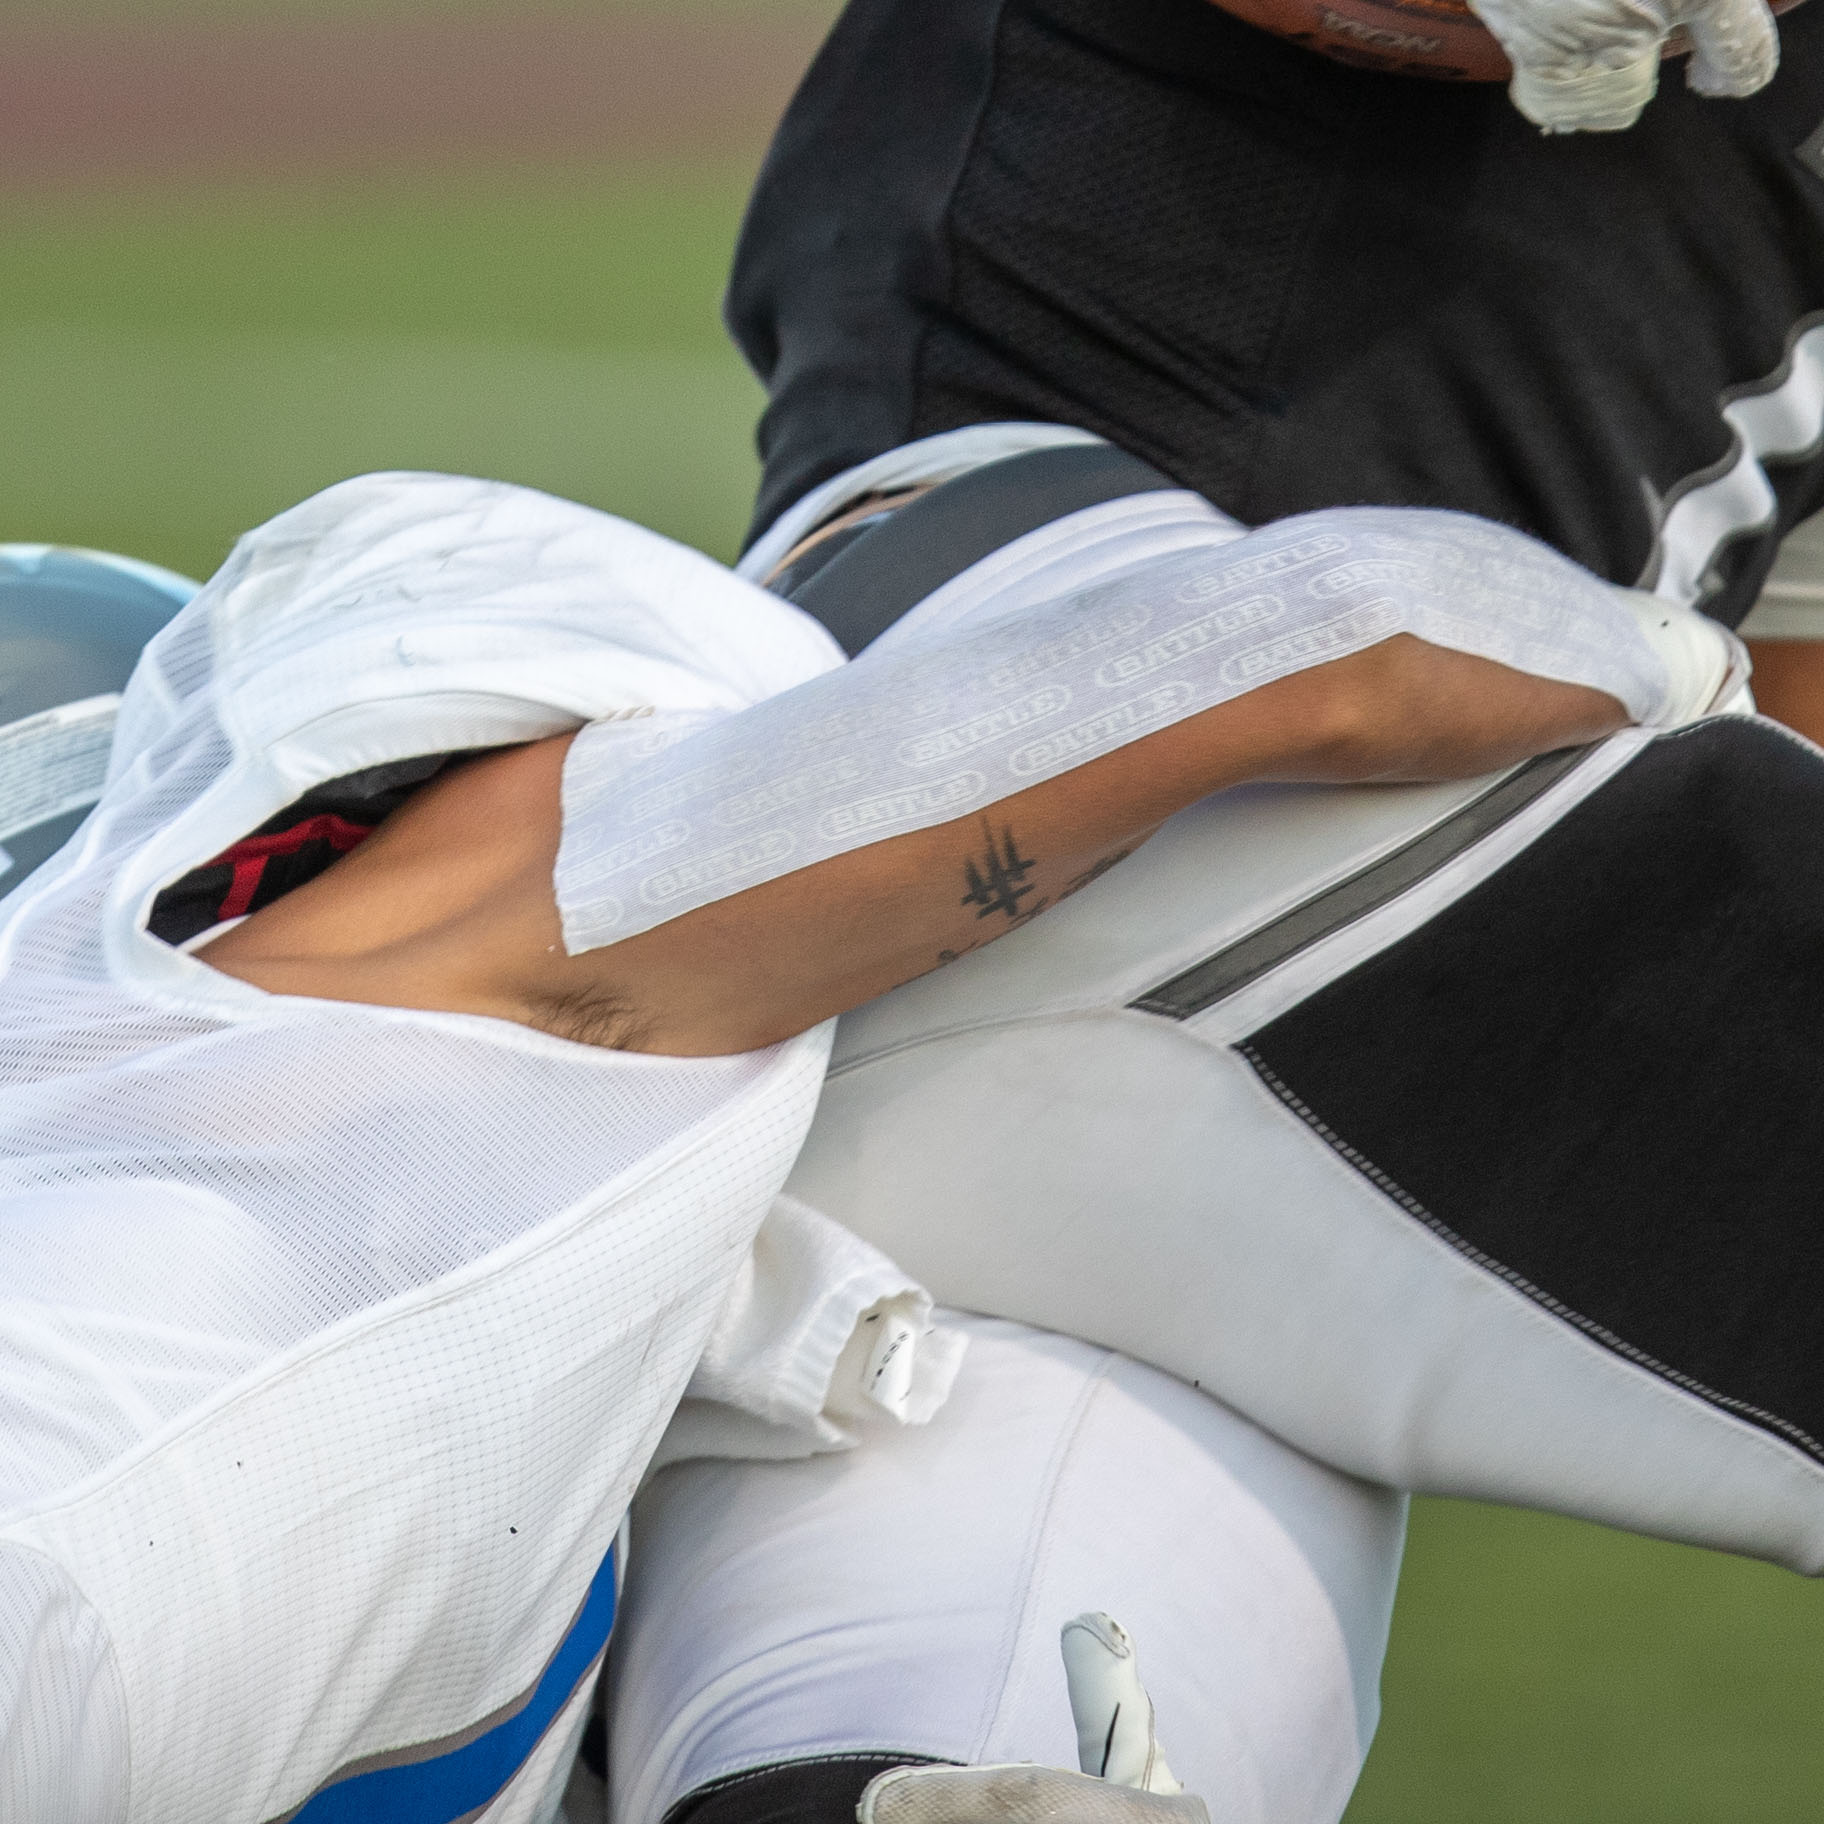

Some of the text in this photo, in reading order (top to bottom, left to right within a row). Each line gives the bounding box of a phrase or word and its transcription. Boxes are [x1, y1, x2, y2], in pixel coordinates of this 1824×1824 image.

[1115, 598, 1273, 676] BATTLE
[912, 689, 1057, 762] BATTLE
[1025, 684, 1180, 766] BATTLE
[829, 777, 973, 826] BATTLE
[654, 834, 783, 896] BATTLE
